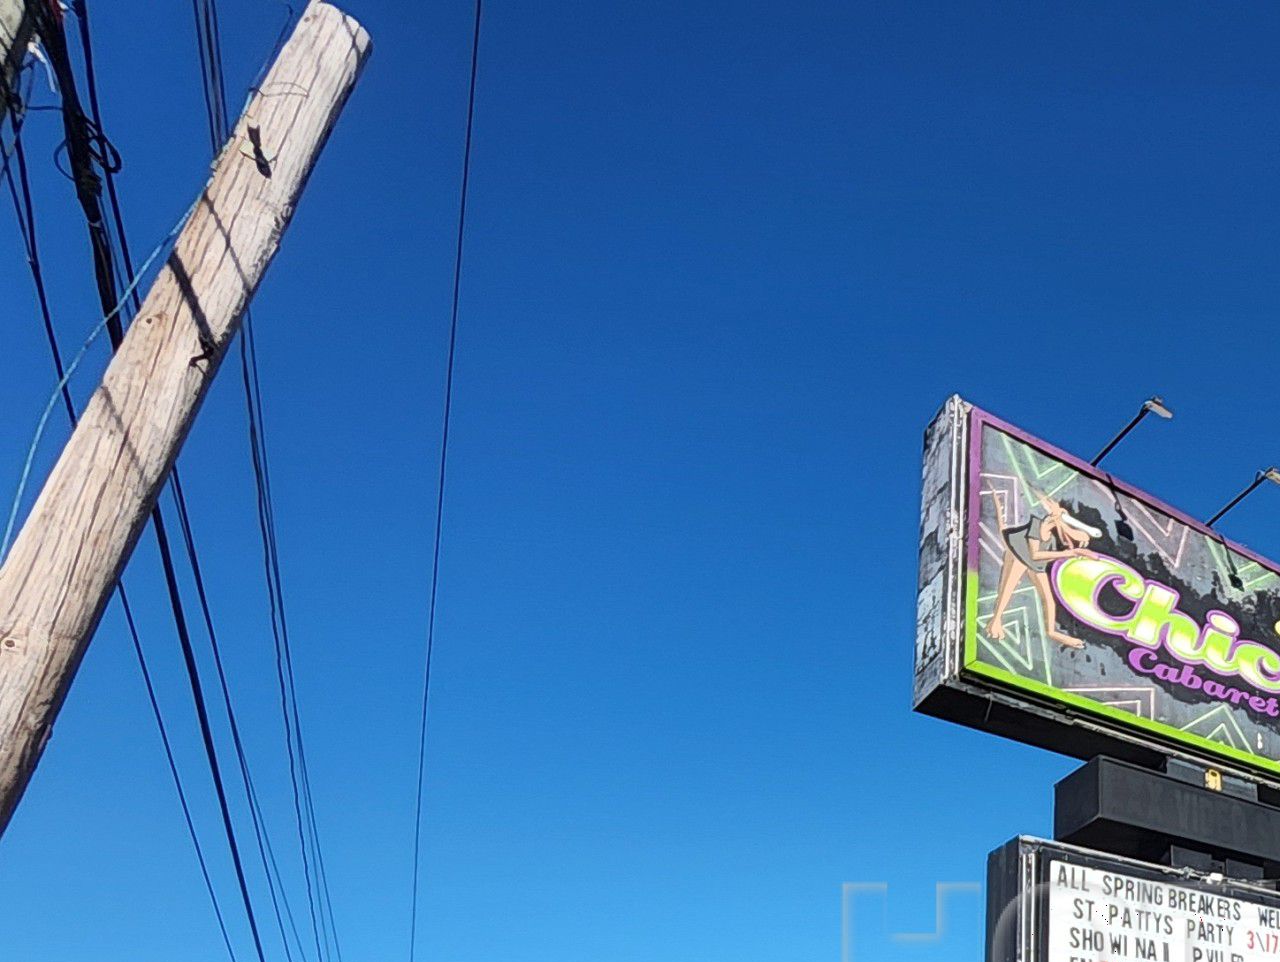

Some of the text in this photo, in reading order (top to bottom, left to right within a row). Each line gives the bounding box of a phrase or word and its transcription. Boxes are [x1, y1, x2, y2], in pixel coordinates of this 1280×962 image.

[1128, 647, 1280, 717] Cabaret
[1057, 865, 1090, 892] ALL
[1102, 874, 1163, 905] SPRING
[1168, 888, 1241, 921] BREAKERS
[1073, 898, 1095, 922] ST
[1108, 904, 1174, 935] PATTYS
[1186, 918, 1234, 946] PARTY
